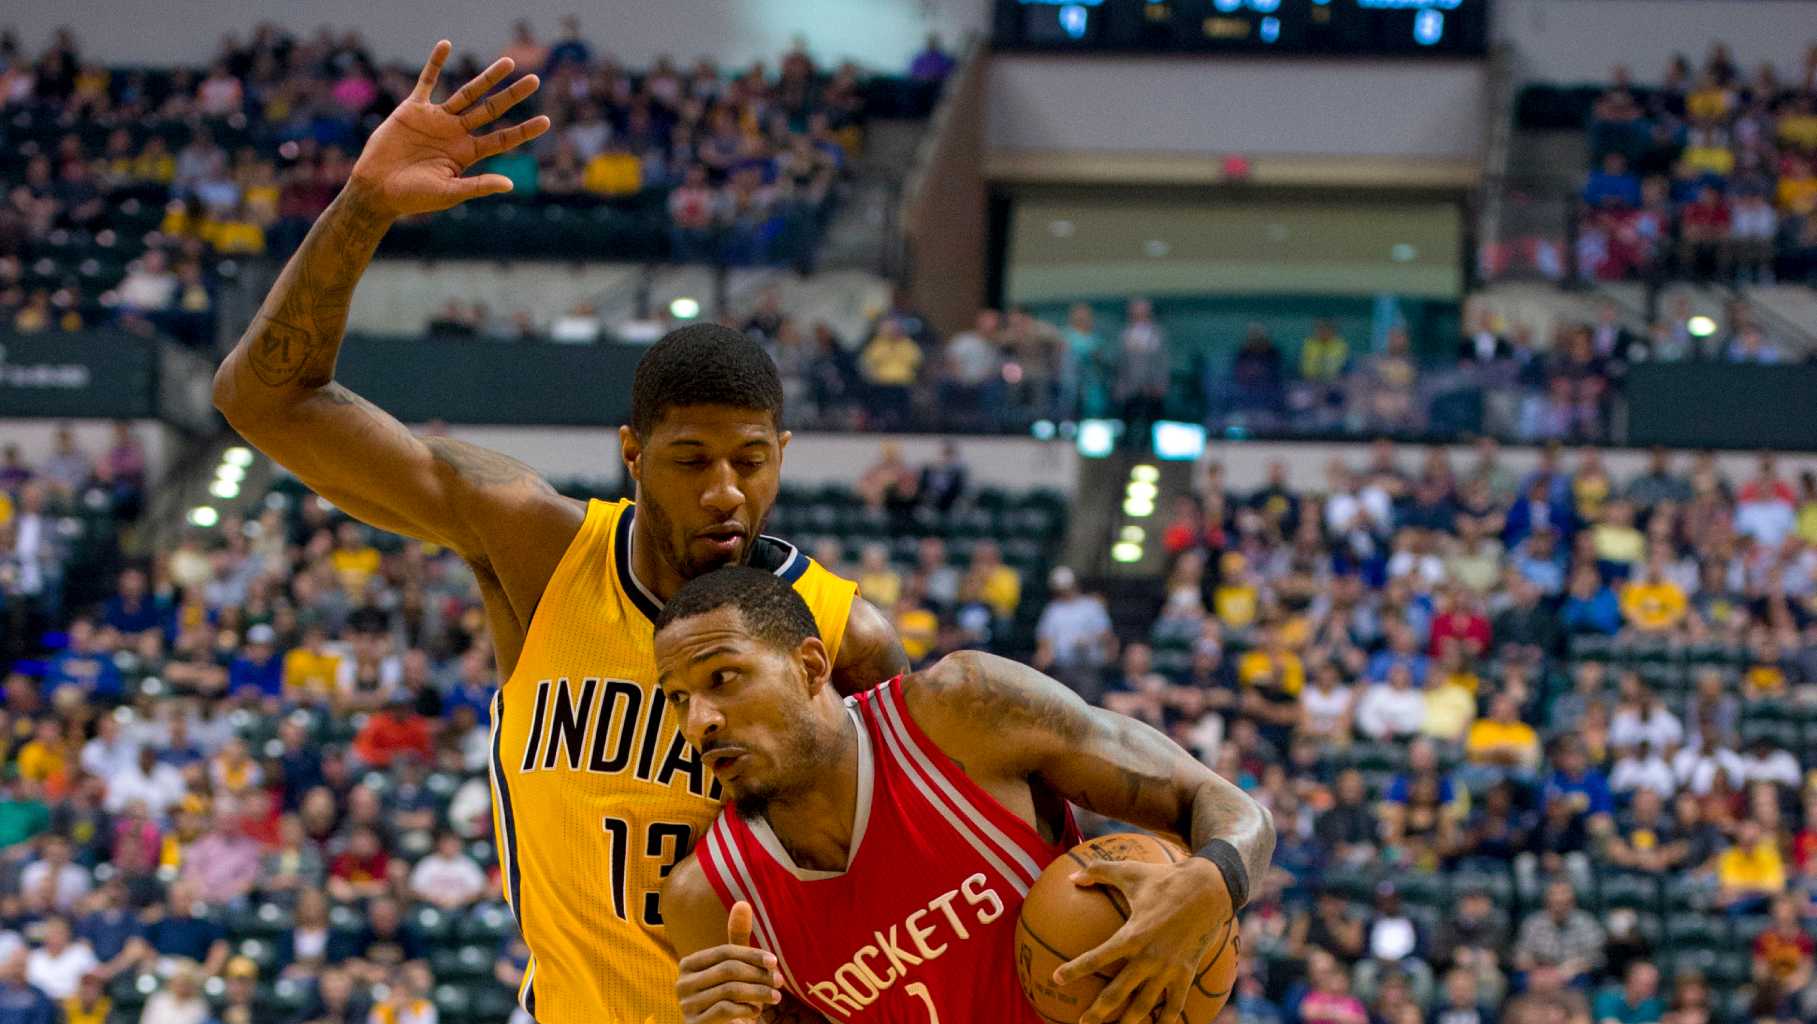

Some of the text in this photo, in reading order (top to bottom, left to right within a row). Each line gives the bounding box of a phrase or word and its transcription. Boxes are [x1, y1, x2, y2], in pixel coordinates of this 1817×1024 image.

[520, 677, 722, 803] INDIA
[602, 816, 692, 927] 13
[806, 872, 1004, 1018] ROCKETS
